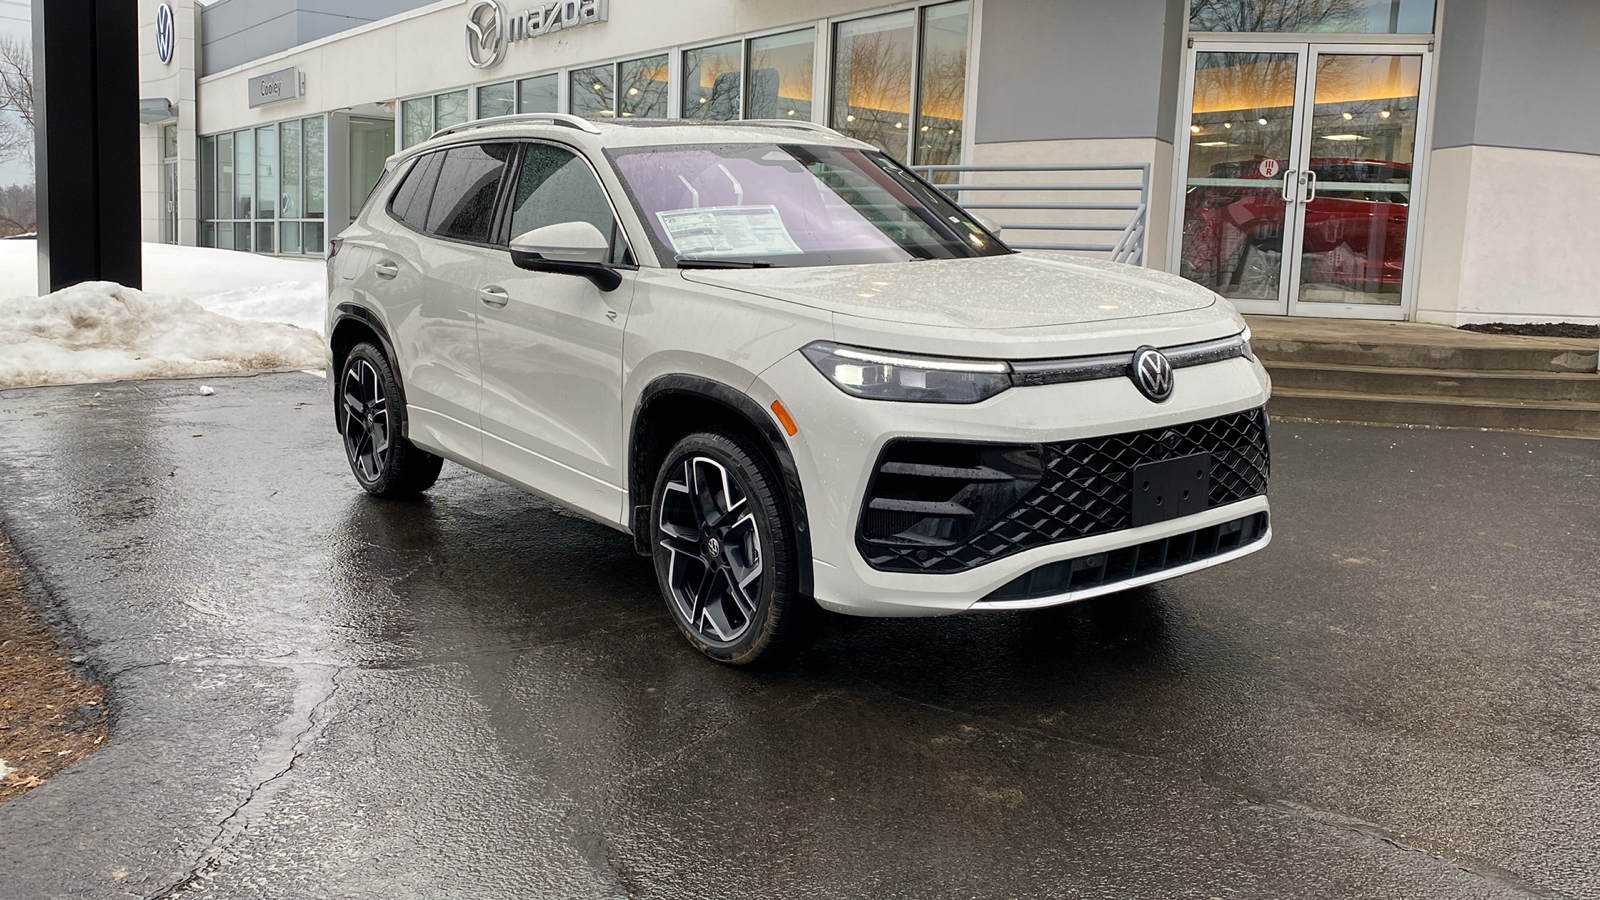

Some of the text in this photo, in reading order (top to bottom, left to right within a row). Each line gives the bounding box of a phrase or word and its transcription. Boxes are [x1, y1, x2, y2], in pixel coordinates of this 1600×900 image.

[507, 0, 608, 43] mazda
[260, 75, 282, 97] Cooley
[1266, 168, 1273, 176] R
